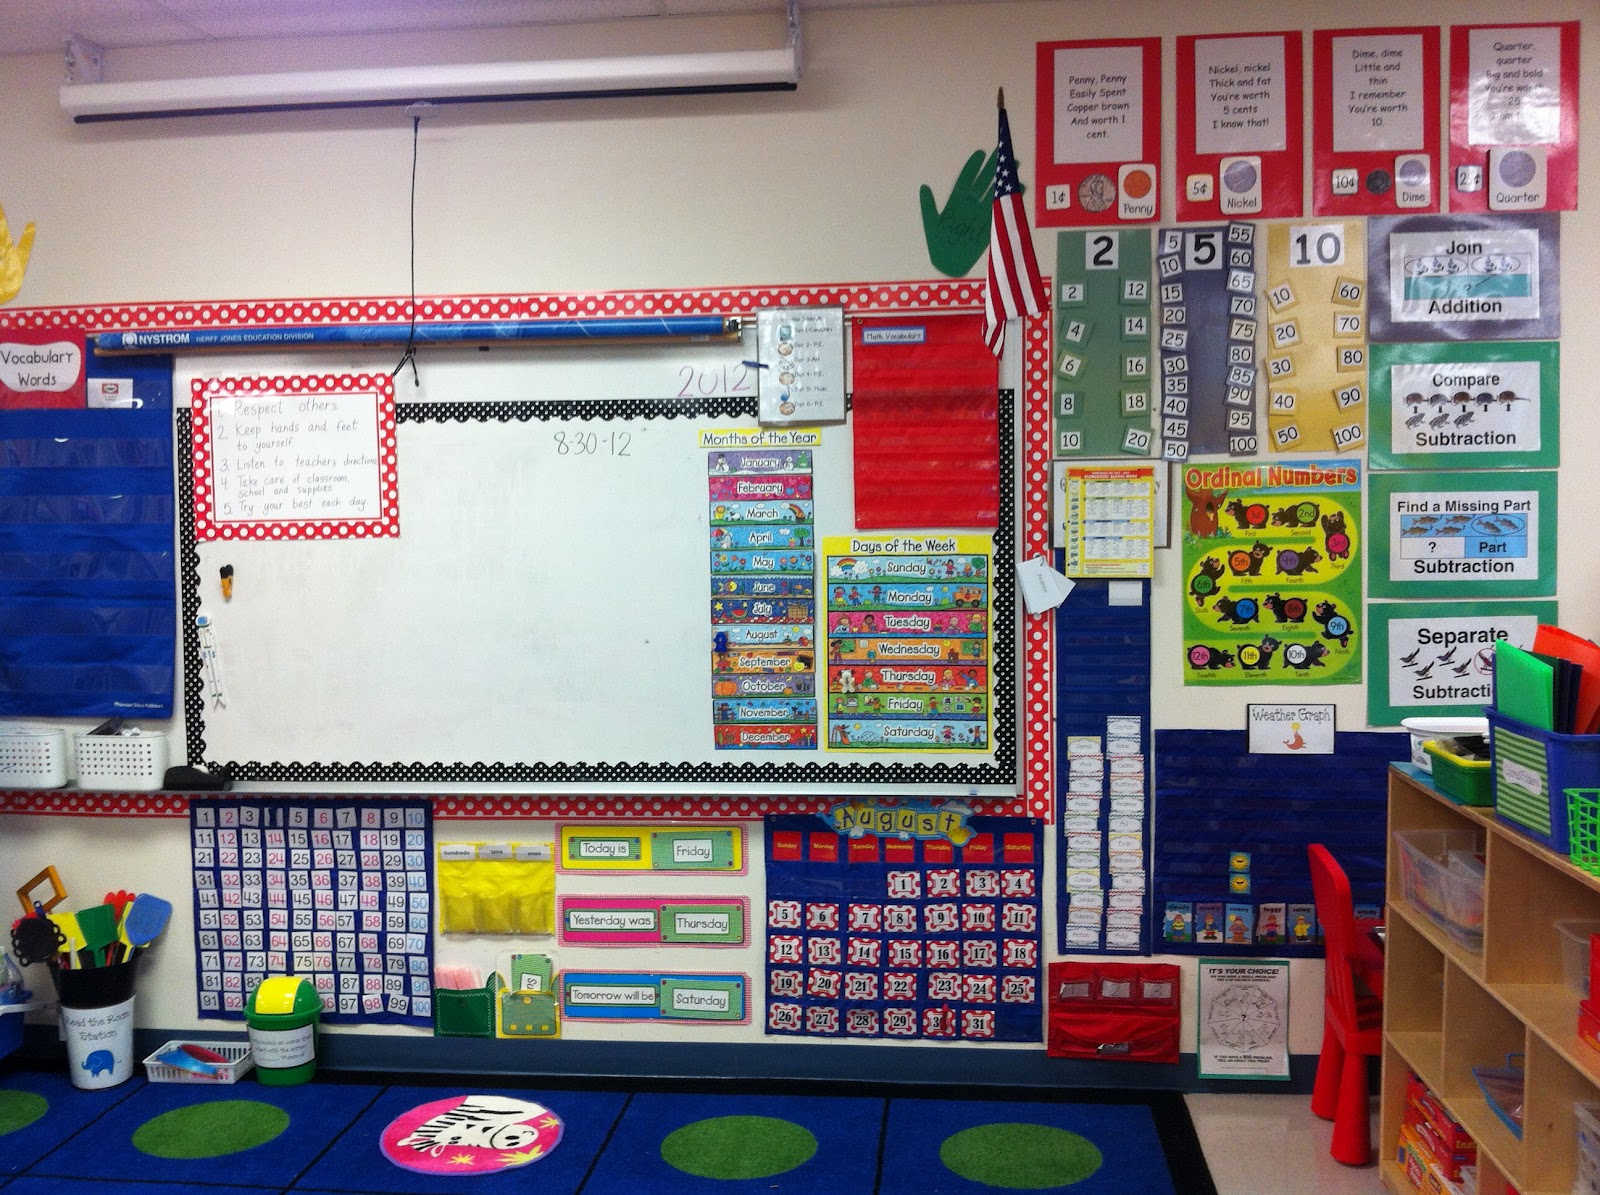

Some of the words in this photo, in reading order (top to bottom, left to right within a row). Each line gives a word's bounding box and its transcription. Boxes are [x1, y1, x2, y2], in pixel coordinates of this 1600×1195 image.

[1353, 49, 1378, 59] Dime,
[1381, 49, 1403, 58] dime
[1209, 64, 1242, 74] Nickel,
[1244, 62, 1271, 72] nickel
[1355, 63, 1381, 73] Little
[1384, 62, 1400, 71] and
[1069, 76, 1099, 86] Penny,
[1101, 74, 1127, 85] Penny
[1209, 78, 1234, 88] Thick
[1237, 77, 1254, 87] and
[1256, 77, 1271, 86] fat
[1370, 76, 1387, 85] thin
[1070, 89, 1096, 99] Easily
[1100, 88, 1126, 98] Spent
[1211, 92, 1240, 102] You're
[1242, 91, 1270, 100] worth
[1350, 91, 1356, 100] I
[1358, 90, 1406, 99] remember
[1067, 103, 1099, 113] Copper
[1102, 102, 1129, 111] brown
[1223, 105, 1229, 114] 5
[1232, 105, 1258, 114] cents
[1348, 105, 1378, 114] You're
[1380, 103, 1407, 112] worth
[1071, 117, 1088, 125] And
[1091, 116, 1119, 125] worth
[1212, 120, 1217, 129] I
[1220, 119, 1243, 128] know
[1247, 117, 1269, 127] that!
[1372, 117, 1383, 126] 10
[1192, 182, 1208, 195] 5¢
[1335, 176, 1355, 189] 10¢
[1052, 191, 1066, 204] 1¢
[1227, 197, 1257, 209] Nickel
[1403, 192, 1425, 202] Dime
[1496, 192, 1539, 204] Quarter
[1124, 204, 1153, 215] Penny
[1230, 228, 1250, 242] 55
[1093, 236, 1114, 267] 2
[1193, 233, 1216, 265] 5
[1296, 233, 1341, 266] 10
[1446, 240, 1482, 254] Join
[1429, 301, 1502, 315] Addition
[867, 332, 883, 340] Math
[1234, 323, 1253, 337] 75
[139, 333, 190, 345] NYSTROM
[284, 333, 313, 341] DIVISION
[0, 350, 74, 366] Vocabulary
[18, 373, 56, 387] Words
[677, 364, 751, 397] 2012
[1433, 372, 1500, 389] Compare
[234, 400, 283, 419] Respect
[236, 423, 262, 439] Keep
[271, 422, 299, 433] hands
[308, 422, 327, 432] and
[336, 419, 358, 430] feet
[1278, 427, 1298, 442] 50
[703, 433, 747, 445] Months
[751, 432, 764, 444] of
[768, 432, 787, 443] the
[789, 431, 816, 443] Year
[1128, 433, 1147, 446] 20
[1231, 437, 1256, 451] 100
[1416, 431, 1516, 446] Subtraction
[237, 441, 247, 451] to
[237, 459, 265, 470] Listen
[275, 457, 283, 466] to
[296, 455, 337, 466] teachers
[741, 458, 780, 468] January
[237, 475, 257, 487] Take
[265, 476, 284, 485] care
[293, 474, 300, 483] of
[1185, 467, 1262, 489] Ordinal
[1268, 465, 1358, 487] Numbers
[239, 488, 265, 498] school
[274, 486, 288, 495] and
[738, 482, 782, 494] February
[240, 502, 253, 515] Try
[264, 502, 283, 516] your
[293, 499, 312, 509] best
[322, 498, 341, 506] each
[747, 508, 778, 518] March
[1298, 507, 1314, 518] 2nd
[1398, 501, 1428, 512] Find
[1433, 503, 1440, 512] a
[1446, 500, 1499, 514] Missing
[1504, 500, 1531, 511] Part
[750, 534, 772, 544] April
[853, 540, 881, 555] Days
[885, 540, 899, 552] of
[903, 539, 922, 551] the
[925, 539, 955, 551] Week
[1428, 542, 1437, 552] ?
[1479, 542, 1507, 553] Part
[753, 557, 773, 568] May
[1234, 557, 1248, 566] 5th
[1414, 560, 1514, 574] Subtraction
[887, 563, 926, 575] Sunday
[753, 581, 775, 592] June
[888, 592, 932, 605] Monday
[753, 604, 772, 615] July
[885, 616, 930, 629] Tuesday
[1331, 621, 1344, 631] 9th
[746, 629, 778, 642] August
[1418, 627, 1508, 648] Separate
[878, 644, 940, 657] Wednesday
[1191, 651, 1208, 661] 12th
[1288, 649, 1305, 660] 10th
[740, 657, 790, 668] September
[882, 670, 935, 684] Thursday
[742, 682, 785, 691] October
[1413, 685, 1490, 699] Subtracti
[888, 698, 922, 711] Friday
[740, 708, 788, 717] November
[1252, 708, 1296, 721] Weather
[1298, 708, 1330, 724] Graph
[742, 732, 790, 742] December
[883, 725, 934, 739] Saturday
[842, 810, 956, 832] August
[583, 842, 614, 856] Today
[618, 843, 627, 854] is
[676, 845, 710, 859] Friday
[778, 842, 797, 850] Sunday
[813, 843, 834, 851] Monday
[293, 854, 309, 865] 25
[573, 913, 626, 928] Yesterday
[629, 915, 651, 925] was
[973, 912, 985, 923] 10
[677, 917, 728, 931] Thursday
[1010, 983, 1024, 994] 25
[572, 990, 621, 1001] Tomorrow
[624, 989, 639, 1000] will
[642, 990, 654, 1001] be
[676, 993, 726, 1009] Saturday
[341, 998, 356, 1009] 97
[414, 1001, 430, 1012] 100
